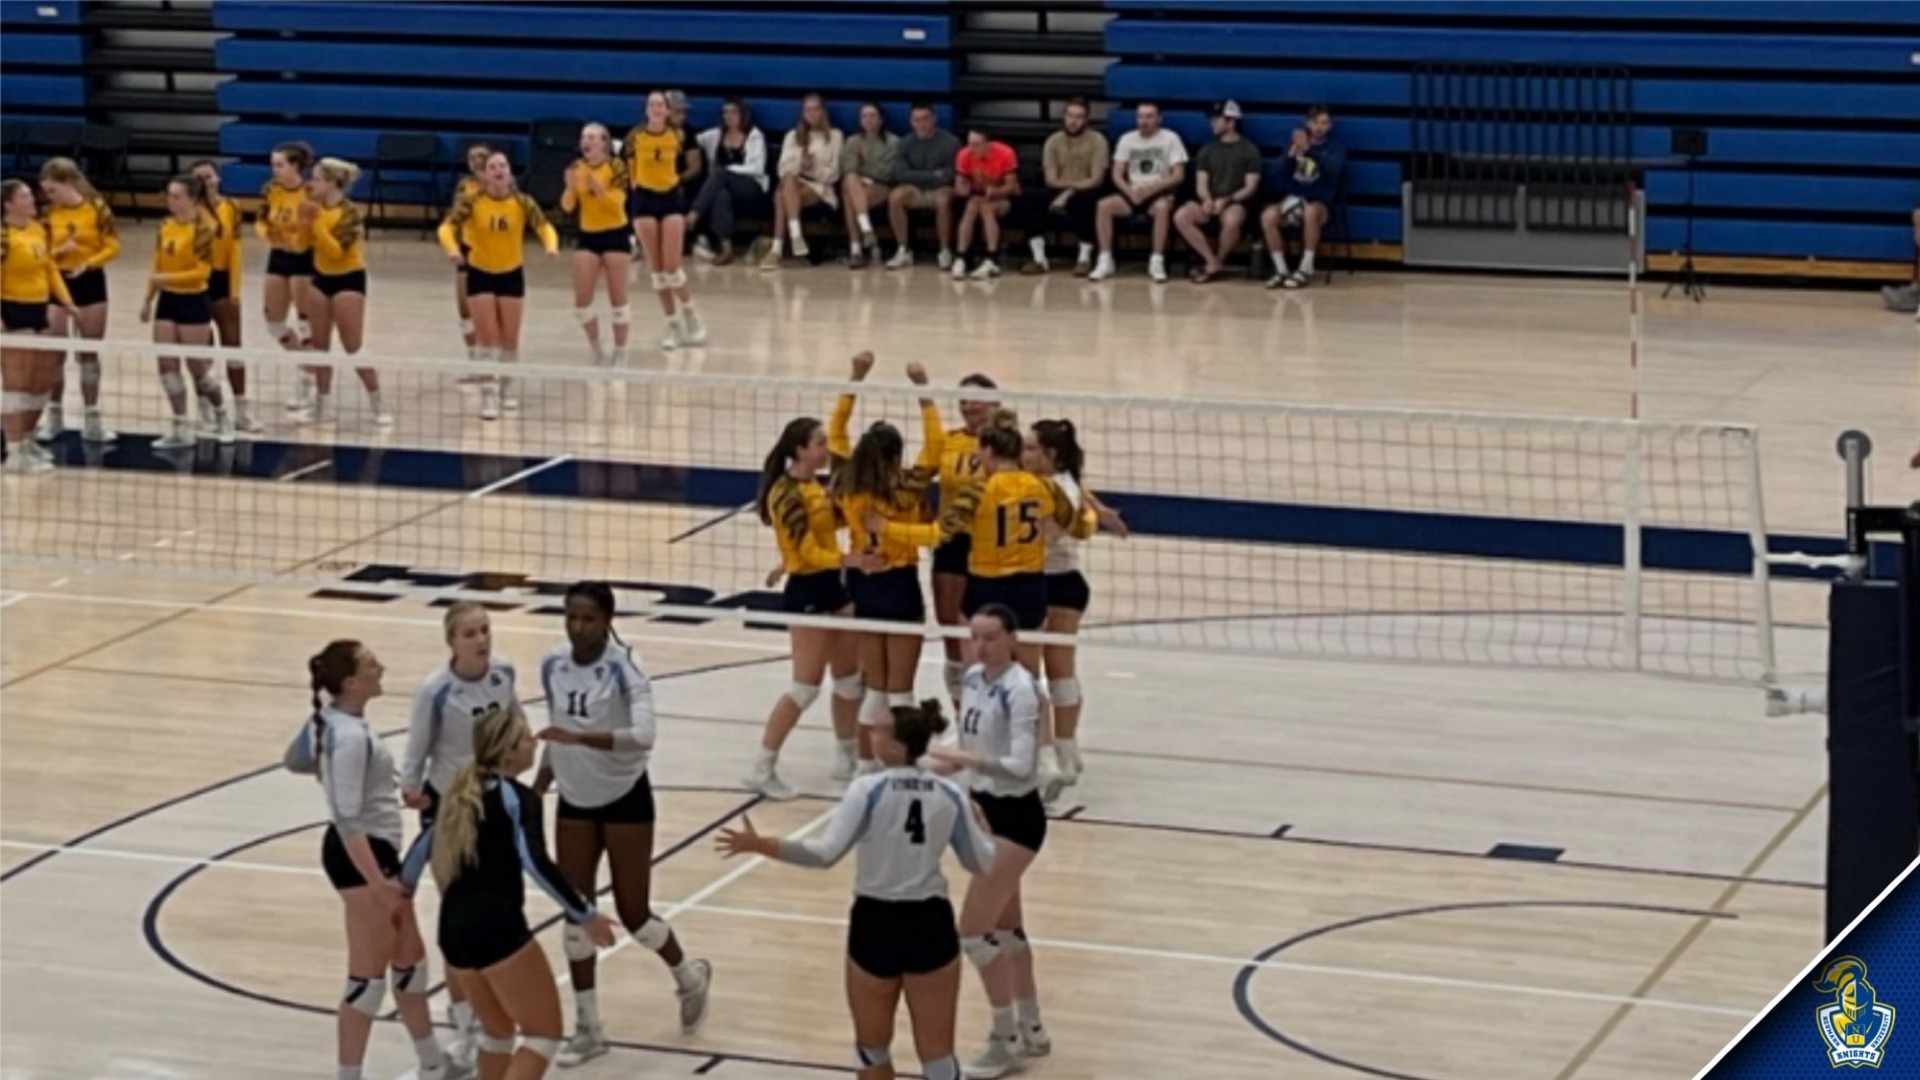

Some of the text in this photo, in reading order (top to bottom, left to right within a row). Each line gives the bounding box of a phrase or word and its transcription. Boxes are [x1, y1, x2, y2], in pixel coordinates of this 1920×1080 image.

[490, 214, 508, 231] 16
[955, 453, 981, 475] 19
[997, 501, 1040, 547] 15
[568, 690, 589, 717] 11
[904, 798, 926, 844] 4
